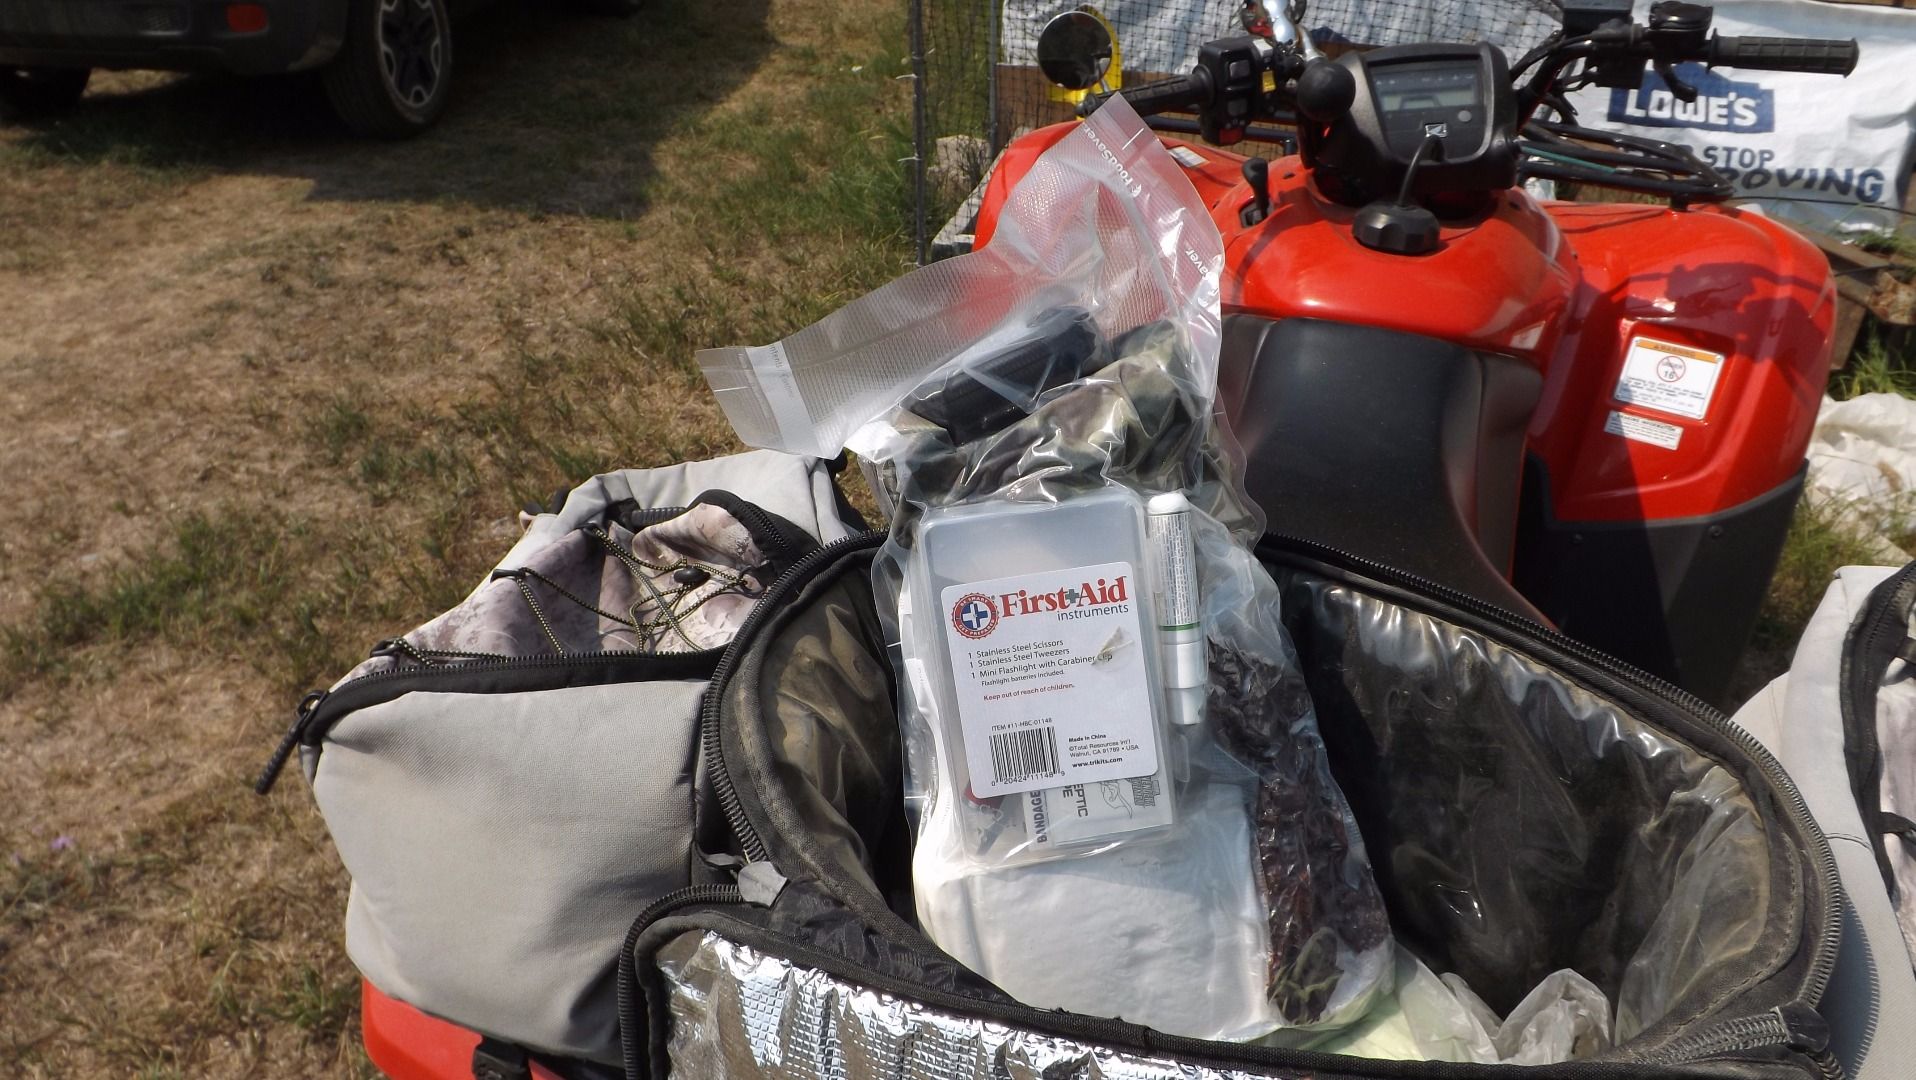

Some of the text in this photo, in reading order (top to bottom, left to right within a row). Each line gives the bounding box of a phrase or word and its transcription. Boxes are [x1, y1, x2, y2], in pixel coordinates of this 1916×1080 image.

[1625, 89, 1757, 126] LOWE'S
[1083, 126, 1134, 186] FoodSaver
[1703, 145, 1775, 169] STOP
[1664, 370, 1675, 380] 16
[1000, 576, 1129, 618] First Aid
[1057, 603, 1129, 622] instruments
[976, 647, 1010, 658] Stainless
[1012, 642, 1031, 652] Steel
[1033, 639, 1064, 649] Scissors
[977, 657, 1012, 667] Stainless
[1013, 652, 1033, 662] Steel
[1033, 648, 1070, 659] Tweezers
[979, 668, 997, 678] Mini
[998, 662, 1037, 675] Flashlight
[1038, 659, 1056, 669] with
[1057, 656, 1096, 666] Carabiner
[981, 678, 1010, 687] Flashlight
[1010, 673, 1037, 682] batteries
[983, 694, 1001, 702] Keep
[1001, 691, 1012, 699] out
[1013, 689, 1020, 697] of
[1020, 687, 1039, 695] reach
[1046, 682, 1076, 692] children.
[991, 724, 1007, 732] ITEM
[1089, 741, 1119, 749] Resources
[1072, 757, 1123, 768] www.trikits.com
[1003, 775, 1027, 785] 20424
[1030, 771, 1054, 781] 11148
[1030, 790, 1048, 843] BANDAGE
